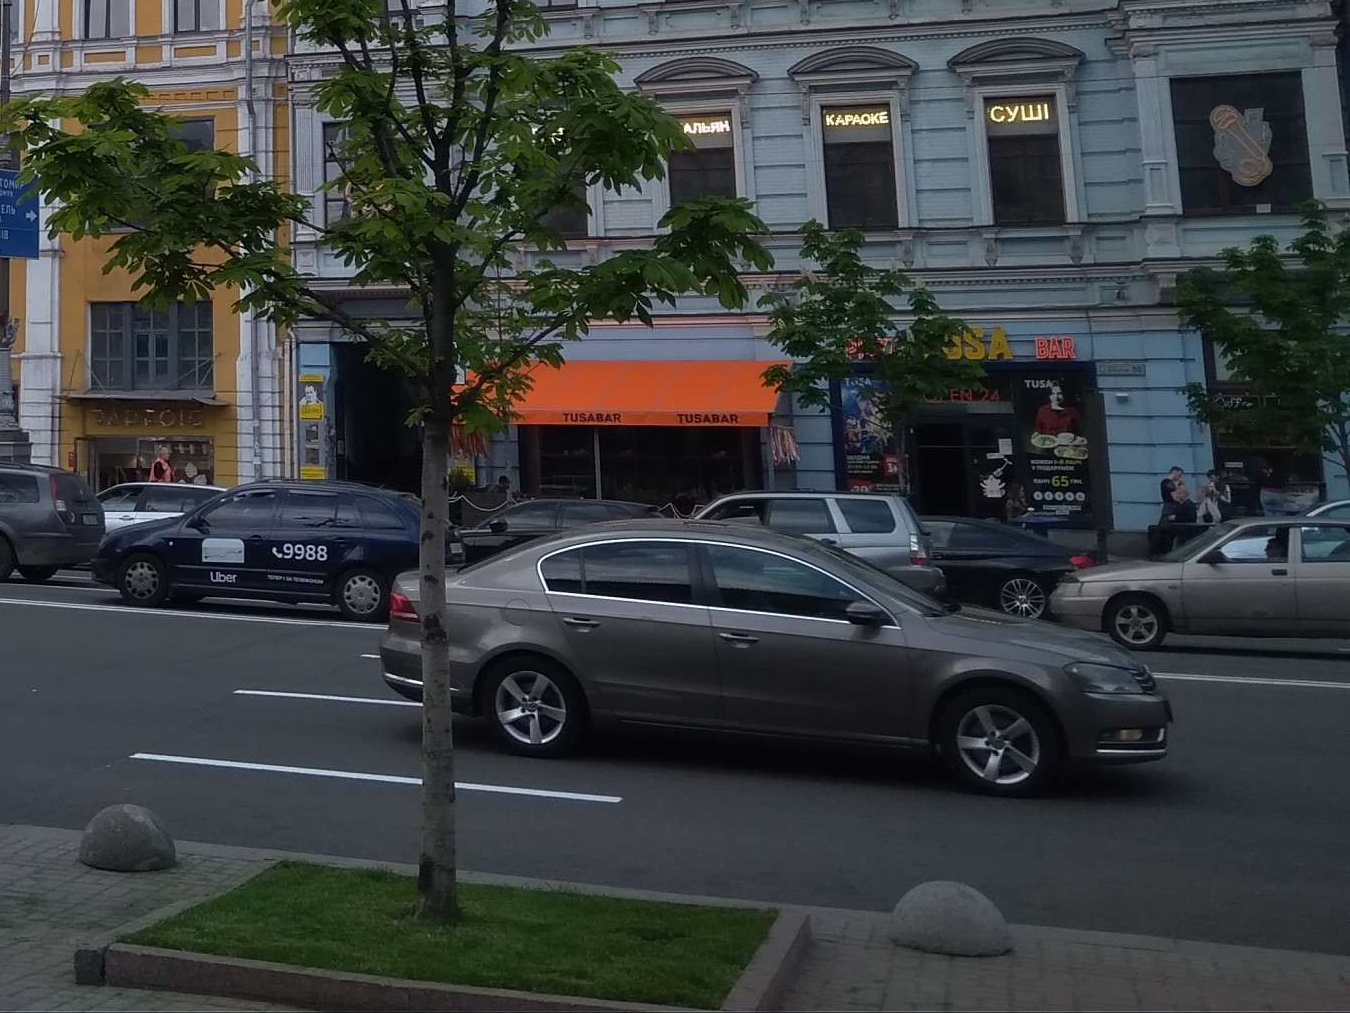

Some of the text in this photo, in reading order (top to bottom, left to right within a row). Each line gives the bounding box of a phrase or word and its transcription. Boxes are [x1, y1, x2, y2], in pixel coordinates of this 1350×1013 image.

[825, 111, 889, 126] КАРАОКЕ
[990, 103, 1049, 123] СУШІ
[681, 120, 731, 135] АЛЬЯН
[941, 327, 1076, 360] USA BAR
[1024, 379, 1053, 388] TUSA
[562, 412, 622, 423] TUSABAR
[677, 413, 739, 424] TUSABAR
[1051, 475, 1069, 487] 65
[282, 543, 328, 561] 9988
[210, 571, 238, 583] Uber
[293, 576, 324, 584] ТЕЛЕФОНОМ
